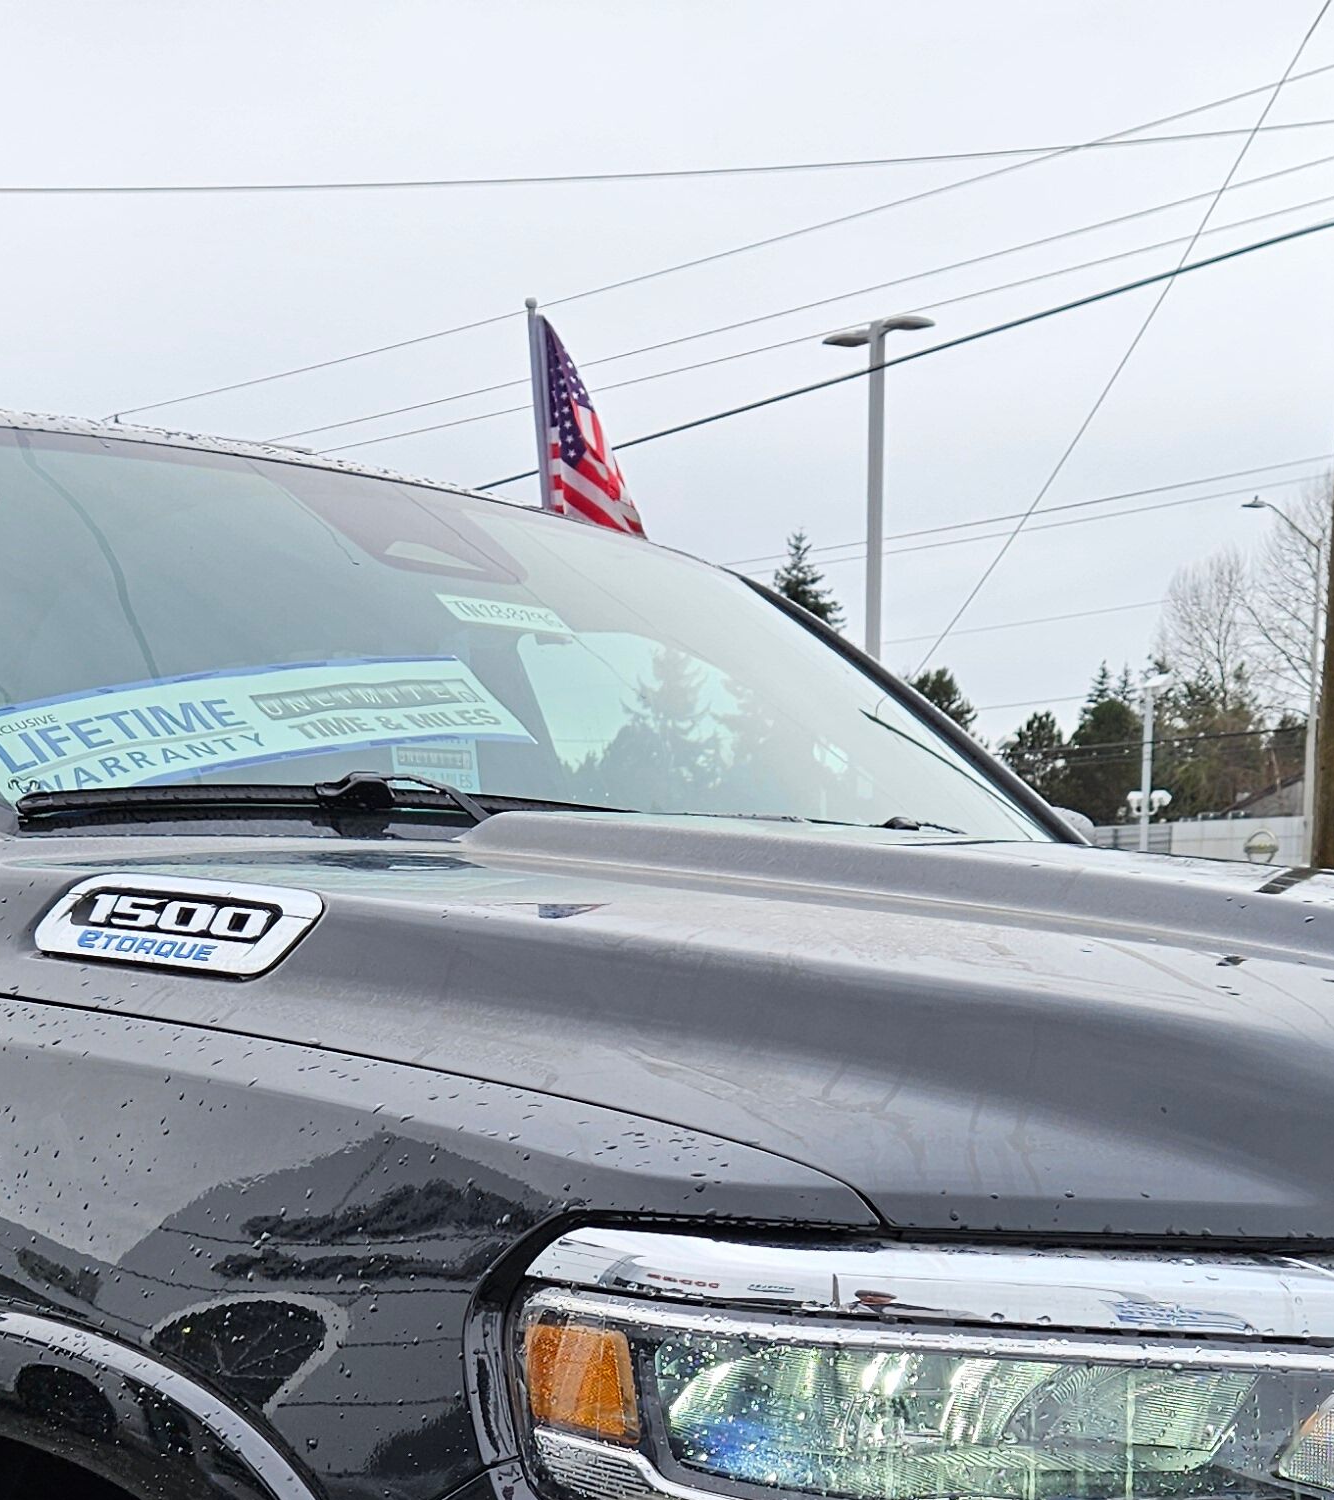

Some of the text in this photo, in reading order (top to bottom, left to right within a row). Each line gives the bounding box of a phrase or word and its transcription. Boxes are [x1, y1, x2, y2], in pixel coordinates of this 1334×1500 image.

[288, 708, 502, 740] TIME & MILES
[88, 893, 272, 940] 1500
[77, 929, 218, 962] eTORQUE
